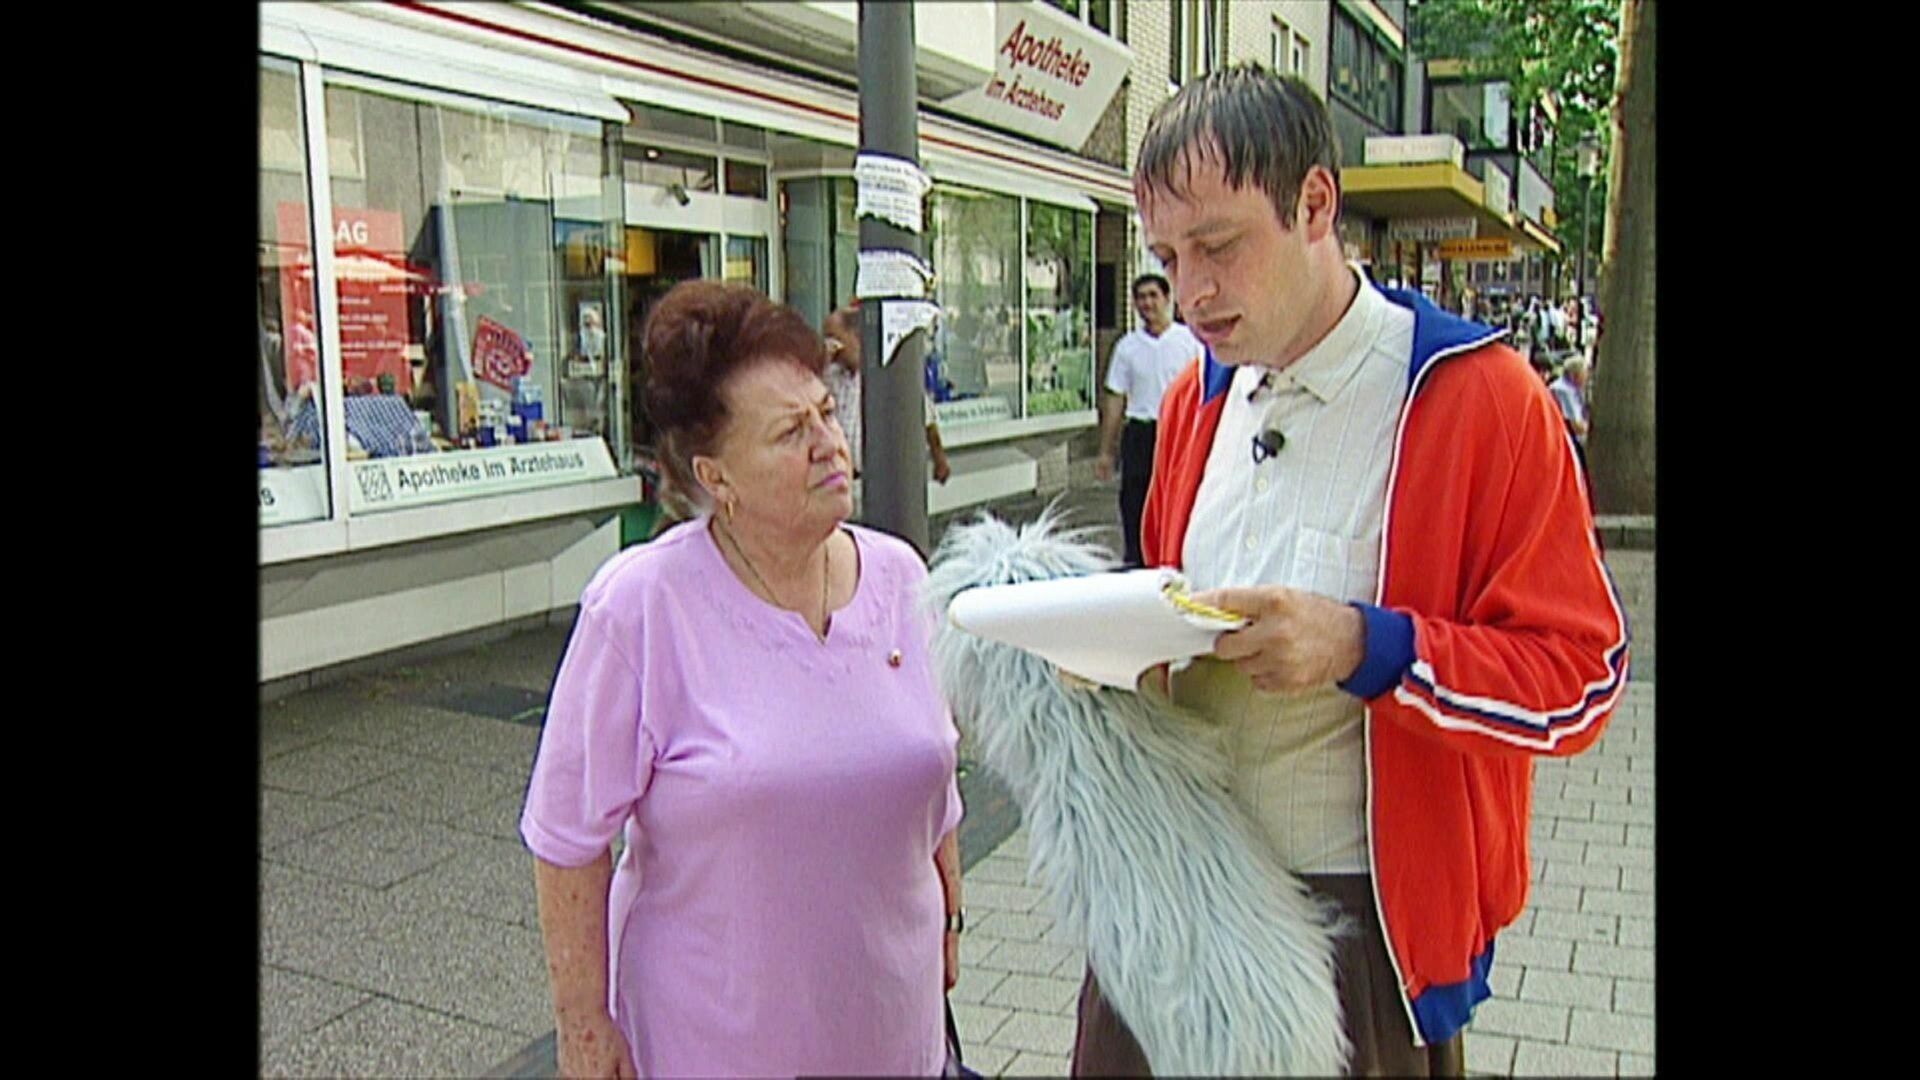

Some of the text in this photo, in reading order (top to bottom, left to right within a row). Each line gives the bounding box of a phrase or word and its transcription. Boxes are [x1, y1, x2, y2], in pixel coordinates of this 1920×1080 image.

[1000, 19, 1091, 87] Apotheke
[398, 460, 481, 493] Apotheke
[482, 459, 506, 478] im
